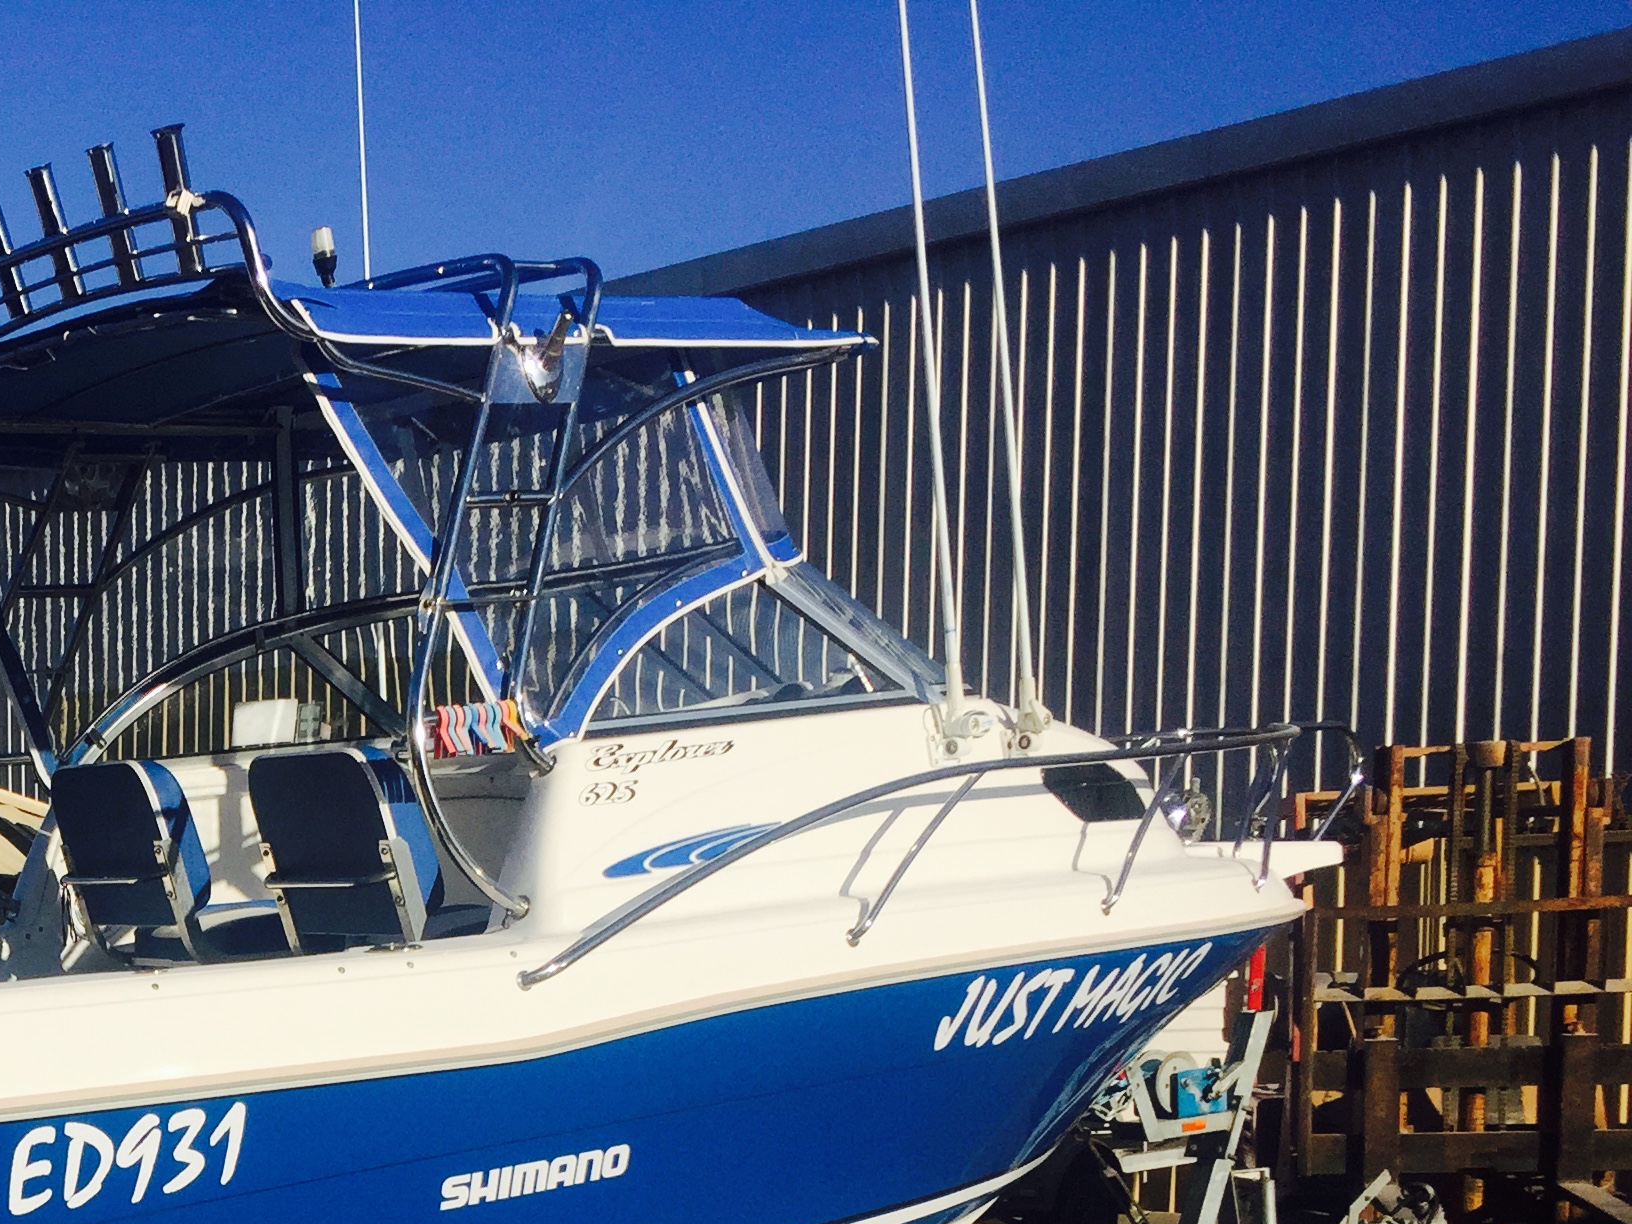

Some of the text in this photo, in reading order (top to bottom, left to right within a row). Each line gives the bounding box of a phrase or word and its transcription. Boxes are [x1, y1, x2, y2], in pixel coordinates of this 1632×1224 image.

[933, 941, 1213, 1052] JUST MAGIC
[9, 1101, 247, 1215] ED931
[439, 1143, 631, 1212] SHIMANO
